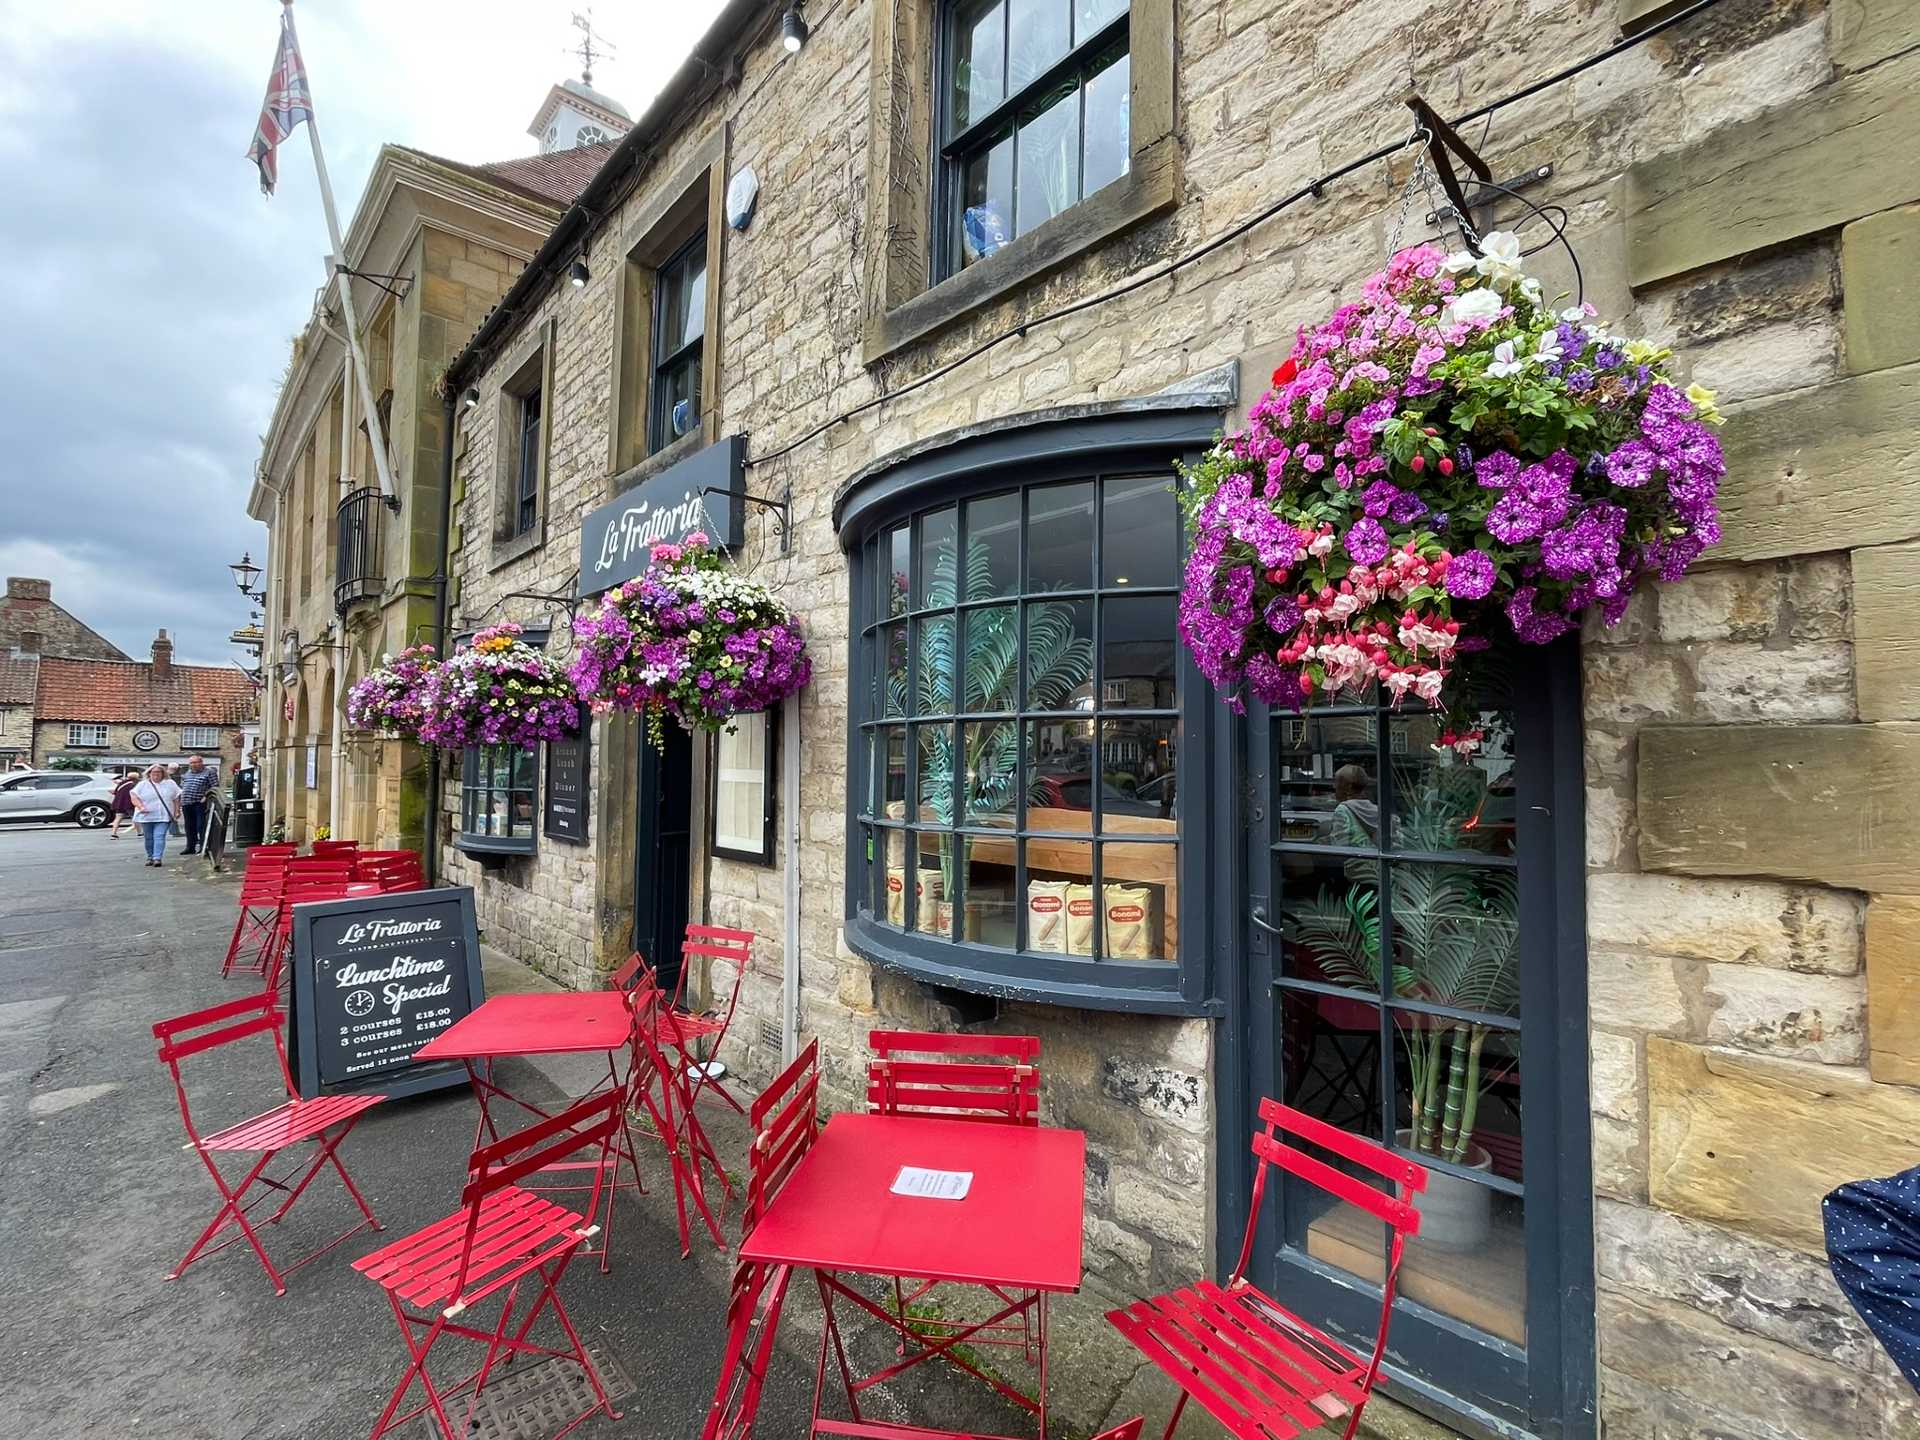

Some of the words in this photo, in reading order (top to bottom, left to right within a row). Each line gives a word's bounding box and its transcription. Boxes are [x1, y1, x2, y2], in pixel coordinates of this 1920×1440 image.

[594, 519, 618, 573] La
[620, 490, 702, 562] Trattoria
[554, 782, 576, 792] Dinner
[337, 923, 366, 945] La
[366, 917, 442, 941] Trattoria
[335, 955, 446, 988] Lunchtime
[383, 974, 452, 1015] Special
[339, 1026, 349, 1035] 2
[352, 1016, 402, 1032] courses
[415, 1007, 451, 1020] £15.00
[340, 1037, 349, 1046] 3
[353, 1028, 403, 1044] courses
[373, 1047, 388, 1055] our
[390, 1042, 413, 1052] menu
[346, 1061, 375, 1073] Served
[499, 1387, 566, 1424] METER
